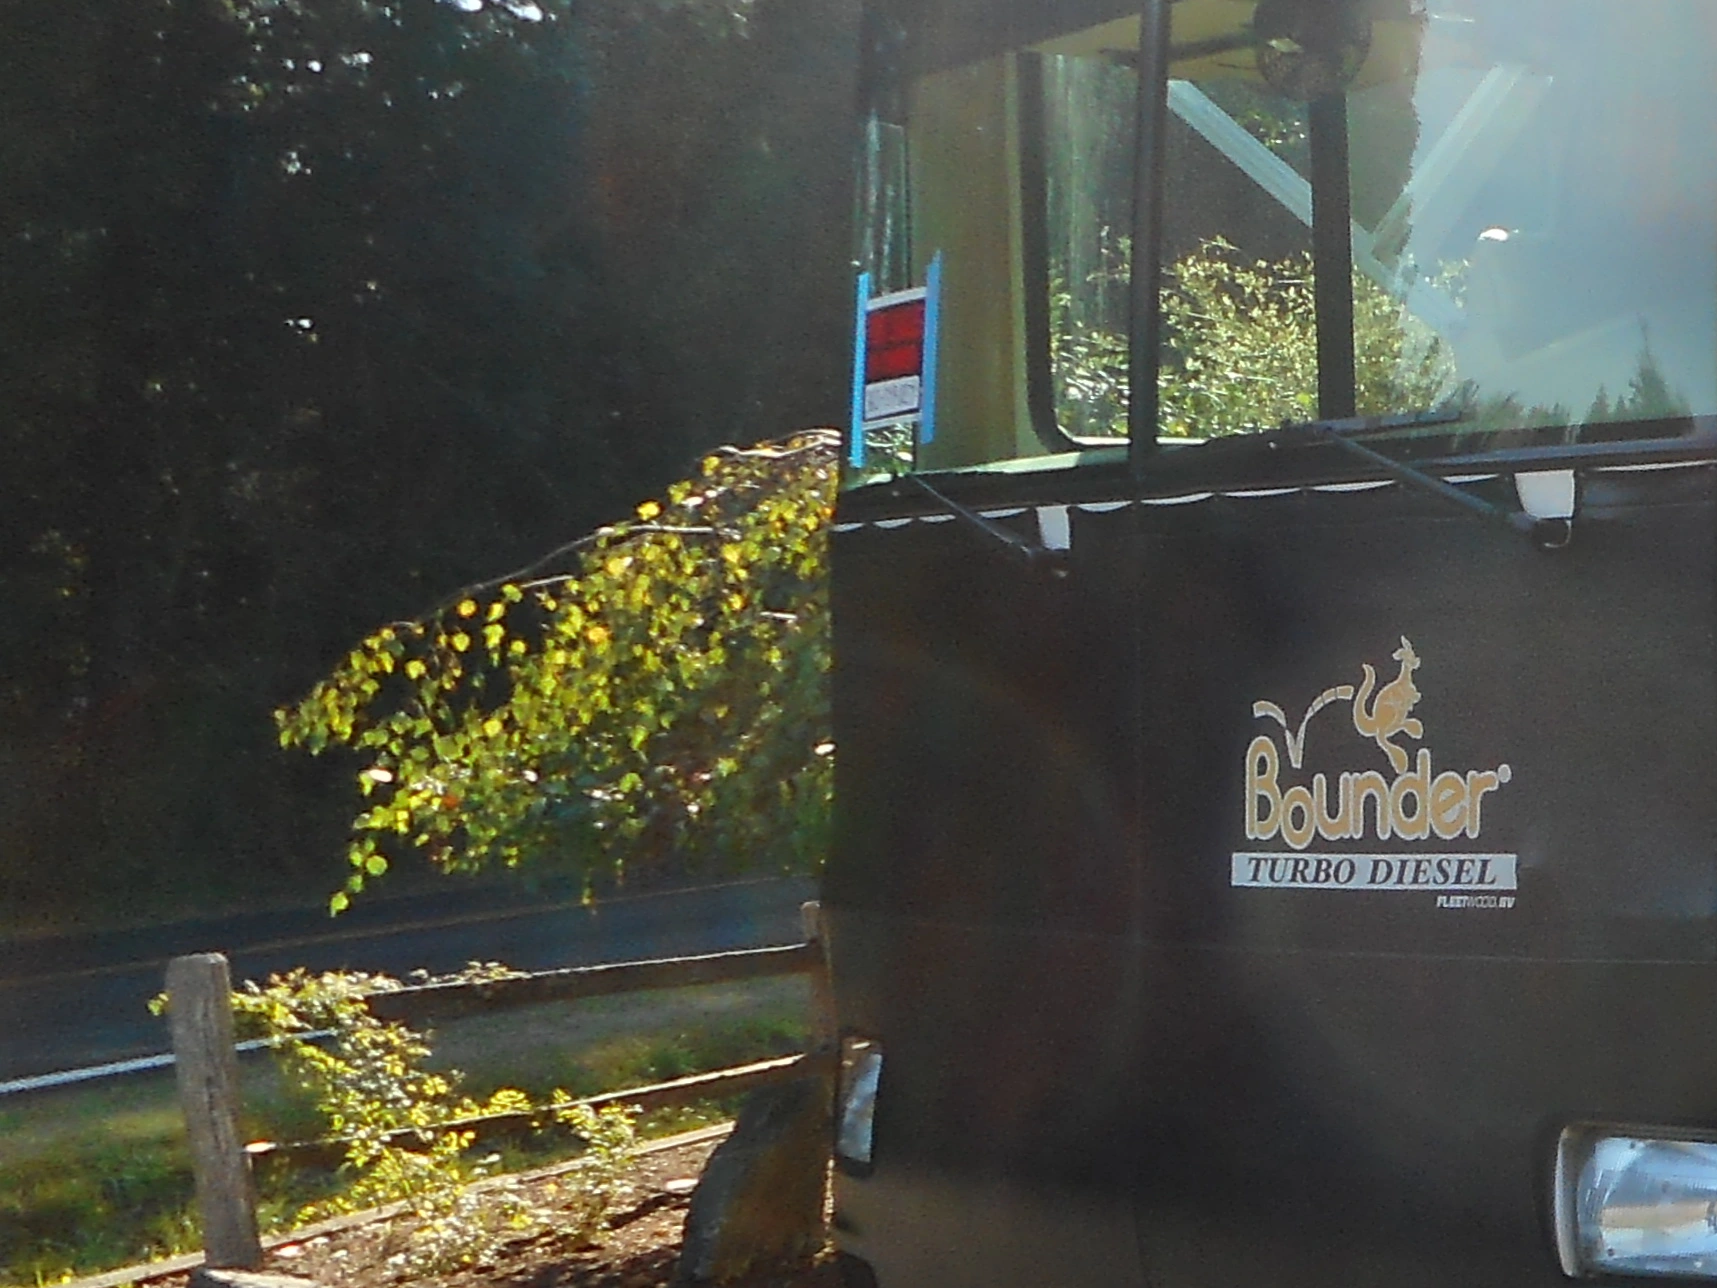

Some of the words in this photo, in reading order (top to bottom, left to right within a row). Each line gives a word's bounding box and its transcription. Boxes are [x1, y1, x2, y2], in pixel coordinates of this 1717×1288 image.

[1246, 735, 1500, 850] Bounder
[1248, 857, 1356, 886] TURBO
[1368, 858, 1498, 887] DIESEL
